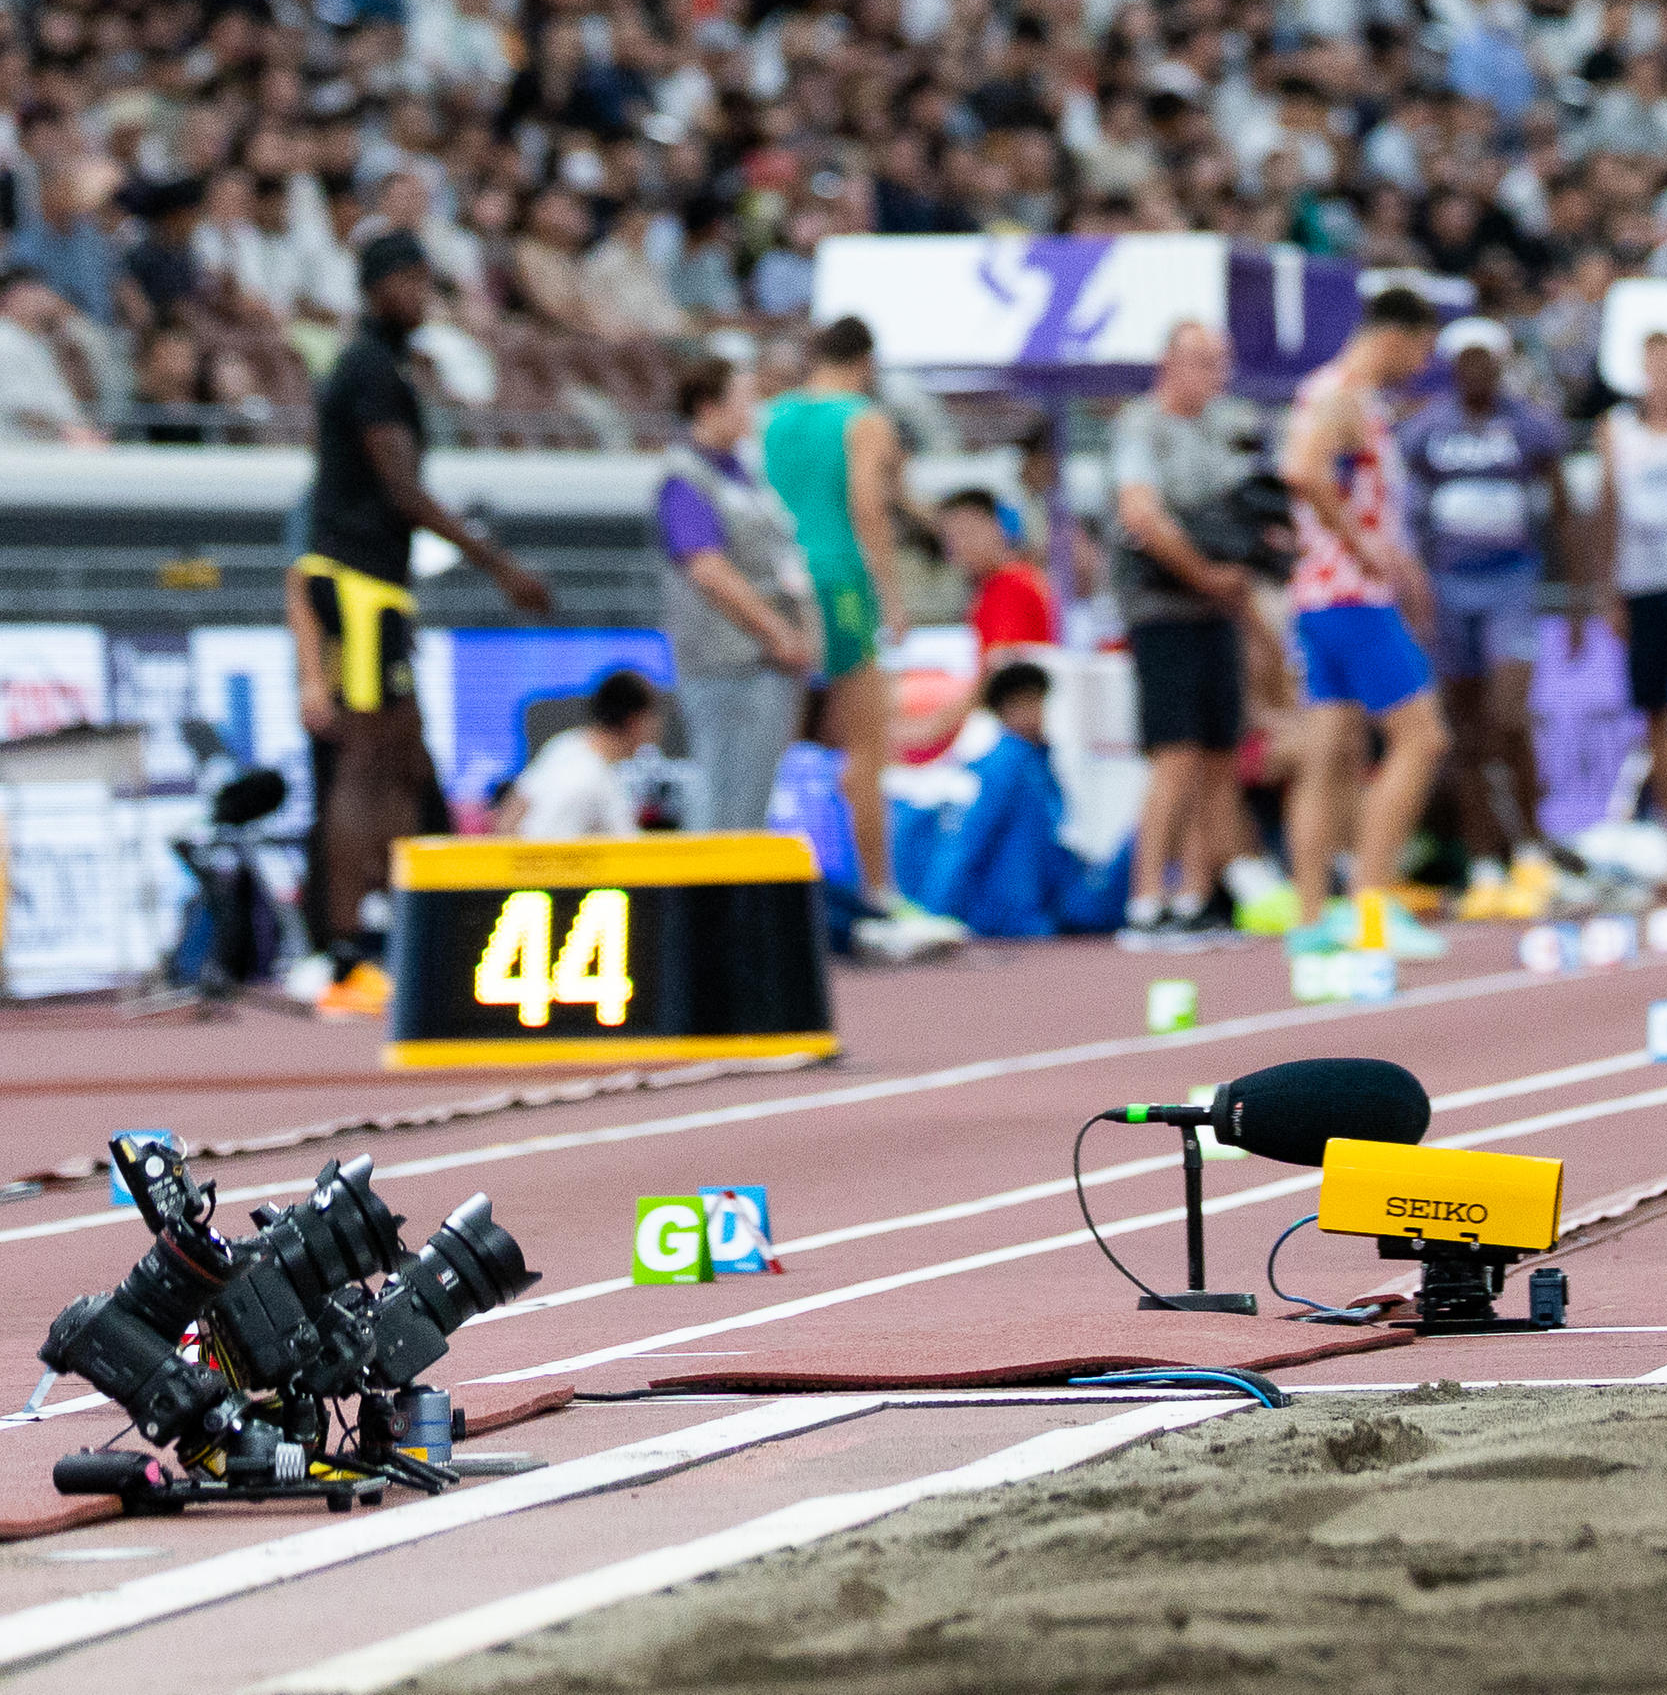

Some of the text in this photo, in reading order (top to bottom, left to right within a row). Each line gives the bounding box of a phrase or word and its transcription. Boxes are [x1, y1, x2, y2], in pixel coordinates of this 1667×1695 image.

[474, 888, 634, 1027] 44
[637, 1204, 700, 1272] G
[1386, 1196, 1488, 1224] SEIKO
